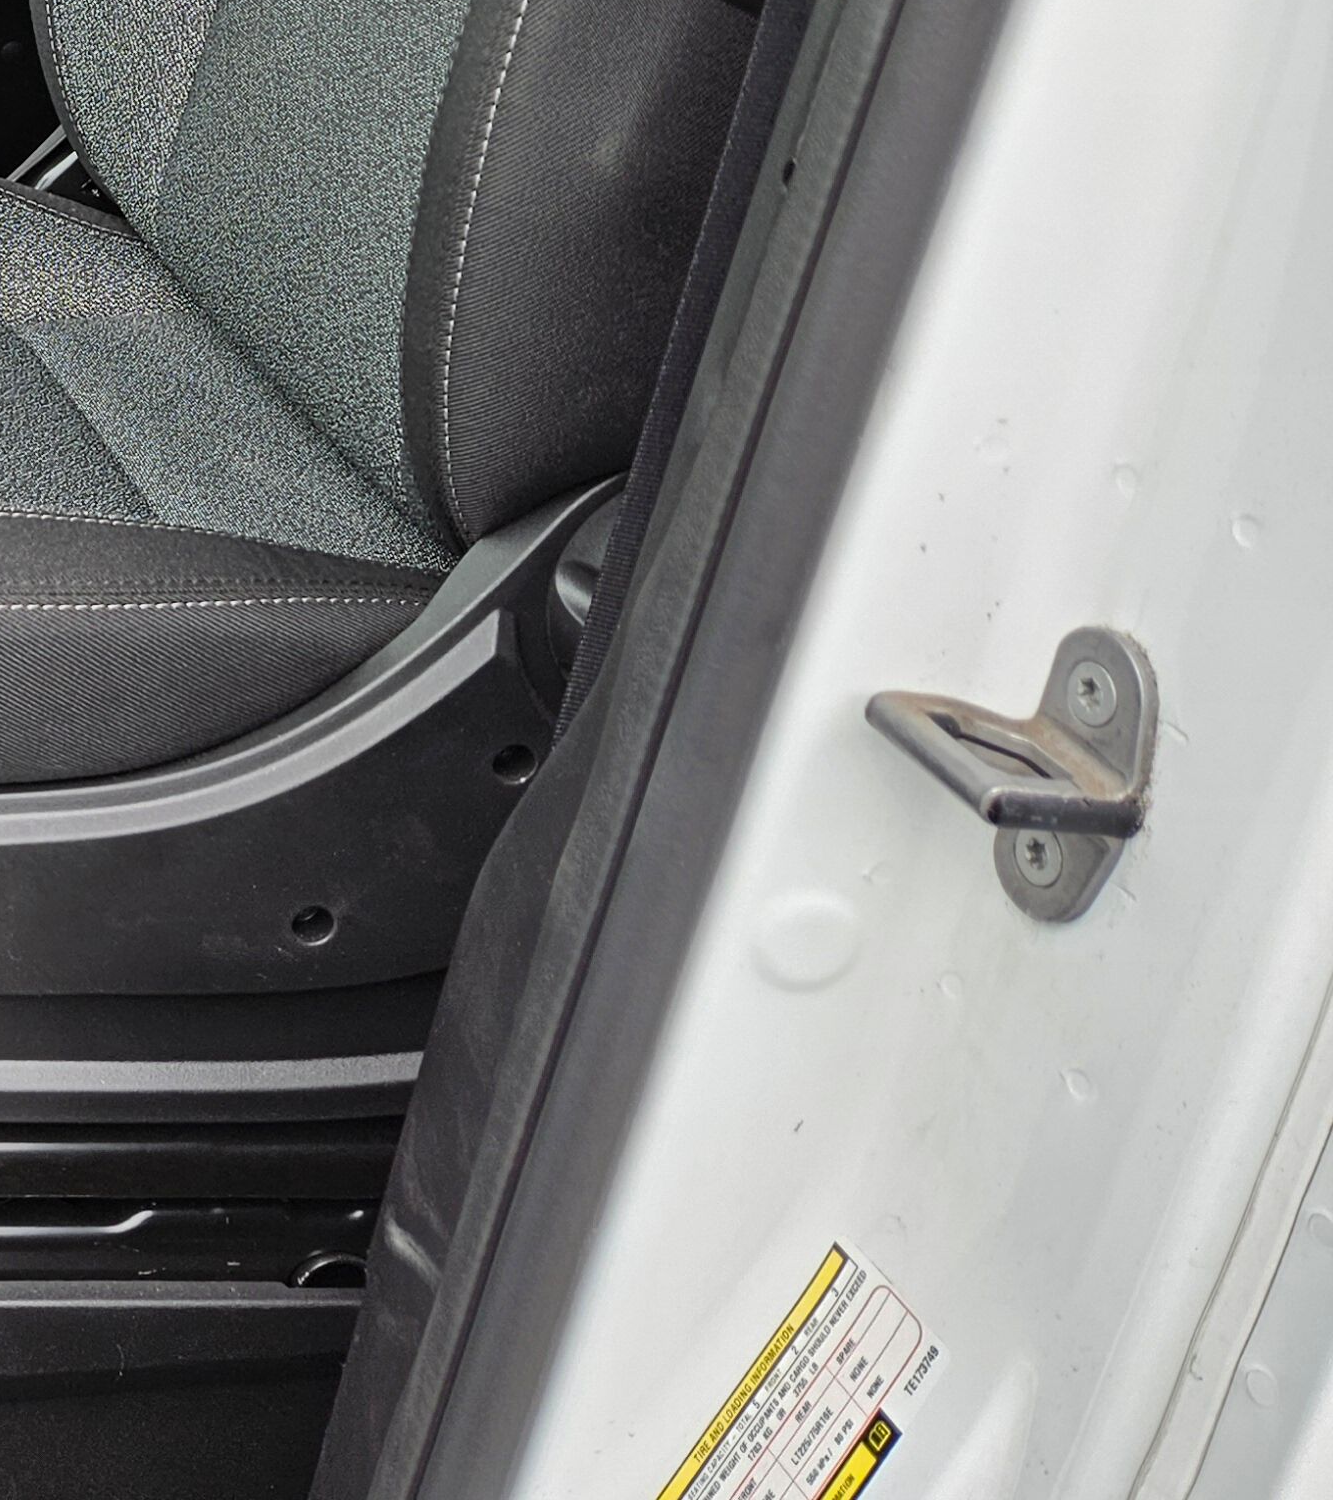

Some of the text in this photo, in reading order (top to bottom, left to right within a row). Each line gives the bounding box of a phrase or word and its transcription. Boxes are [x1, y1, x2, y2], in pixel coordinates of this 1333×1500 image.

[751, 1399, 760, 1409] 5
[790, 1346, 799, 1355] 2
[830, 1287, 839, 1297] 3
[848, 1355, 868, 1382] NONE
[903, 1345, 940, 1396] TE173749
[692, 1323, 795, 1462] TIRE AND LOADING INFORMATION
[719, 1451, 741, 1481] WEIGHT
[739, 1441, 749, 1453] OF
[746, 1398, 779, 1442] OCCUPANTS
[777, 1382, 791, 1399] AND
[789, 1355, 810, 1382] CARGO
[806, 1324, 831, 1357] SHOULD
[827, 1298, 848, 1327] NEVER
[844, 1268, 868, 1301] EXCEED
[866, 1374, 884, 1399] NONE
[795, 1399, 812, 1423] REAR
